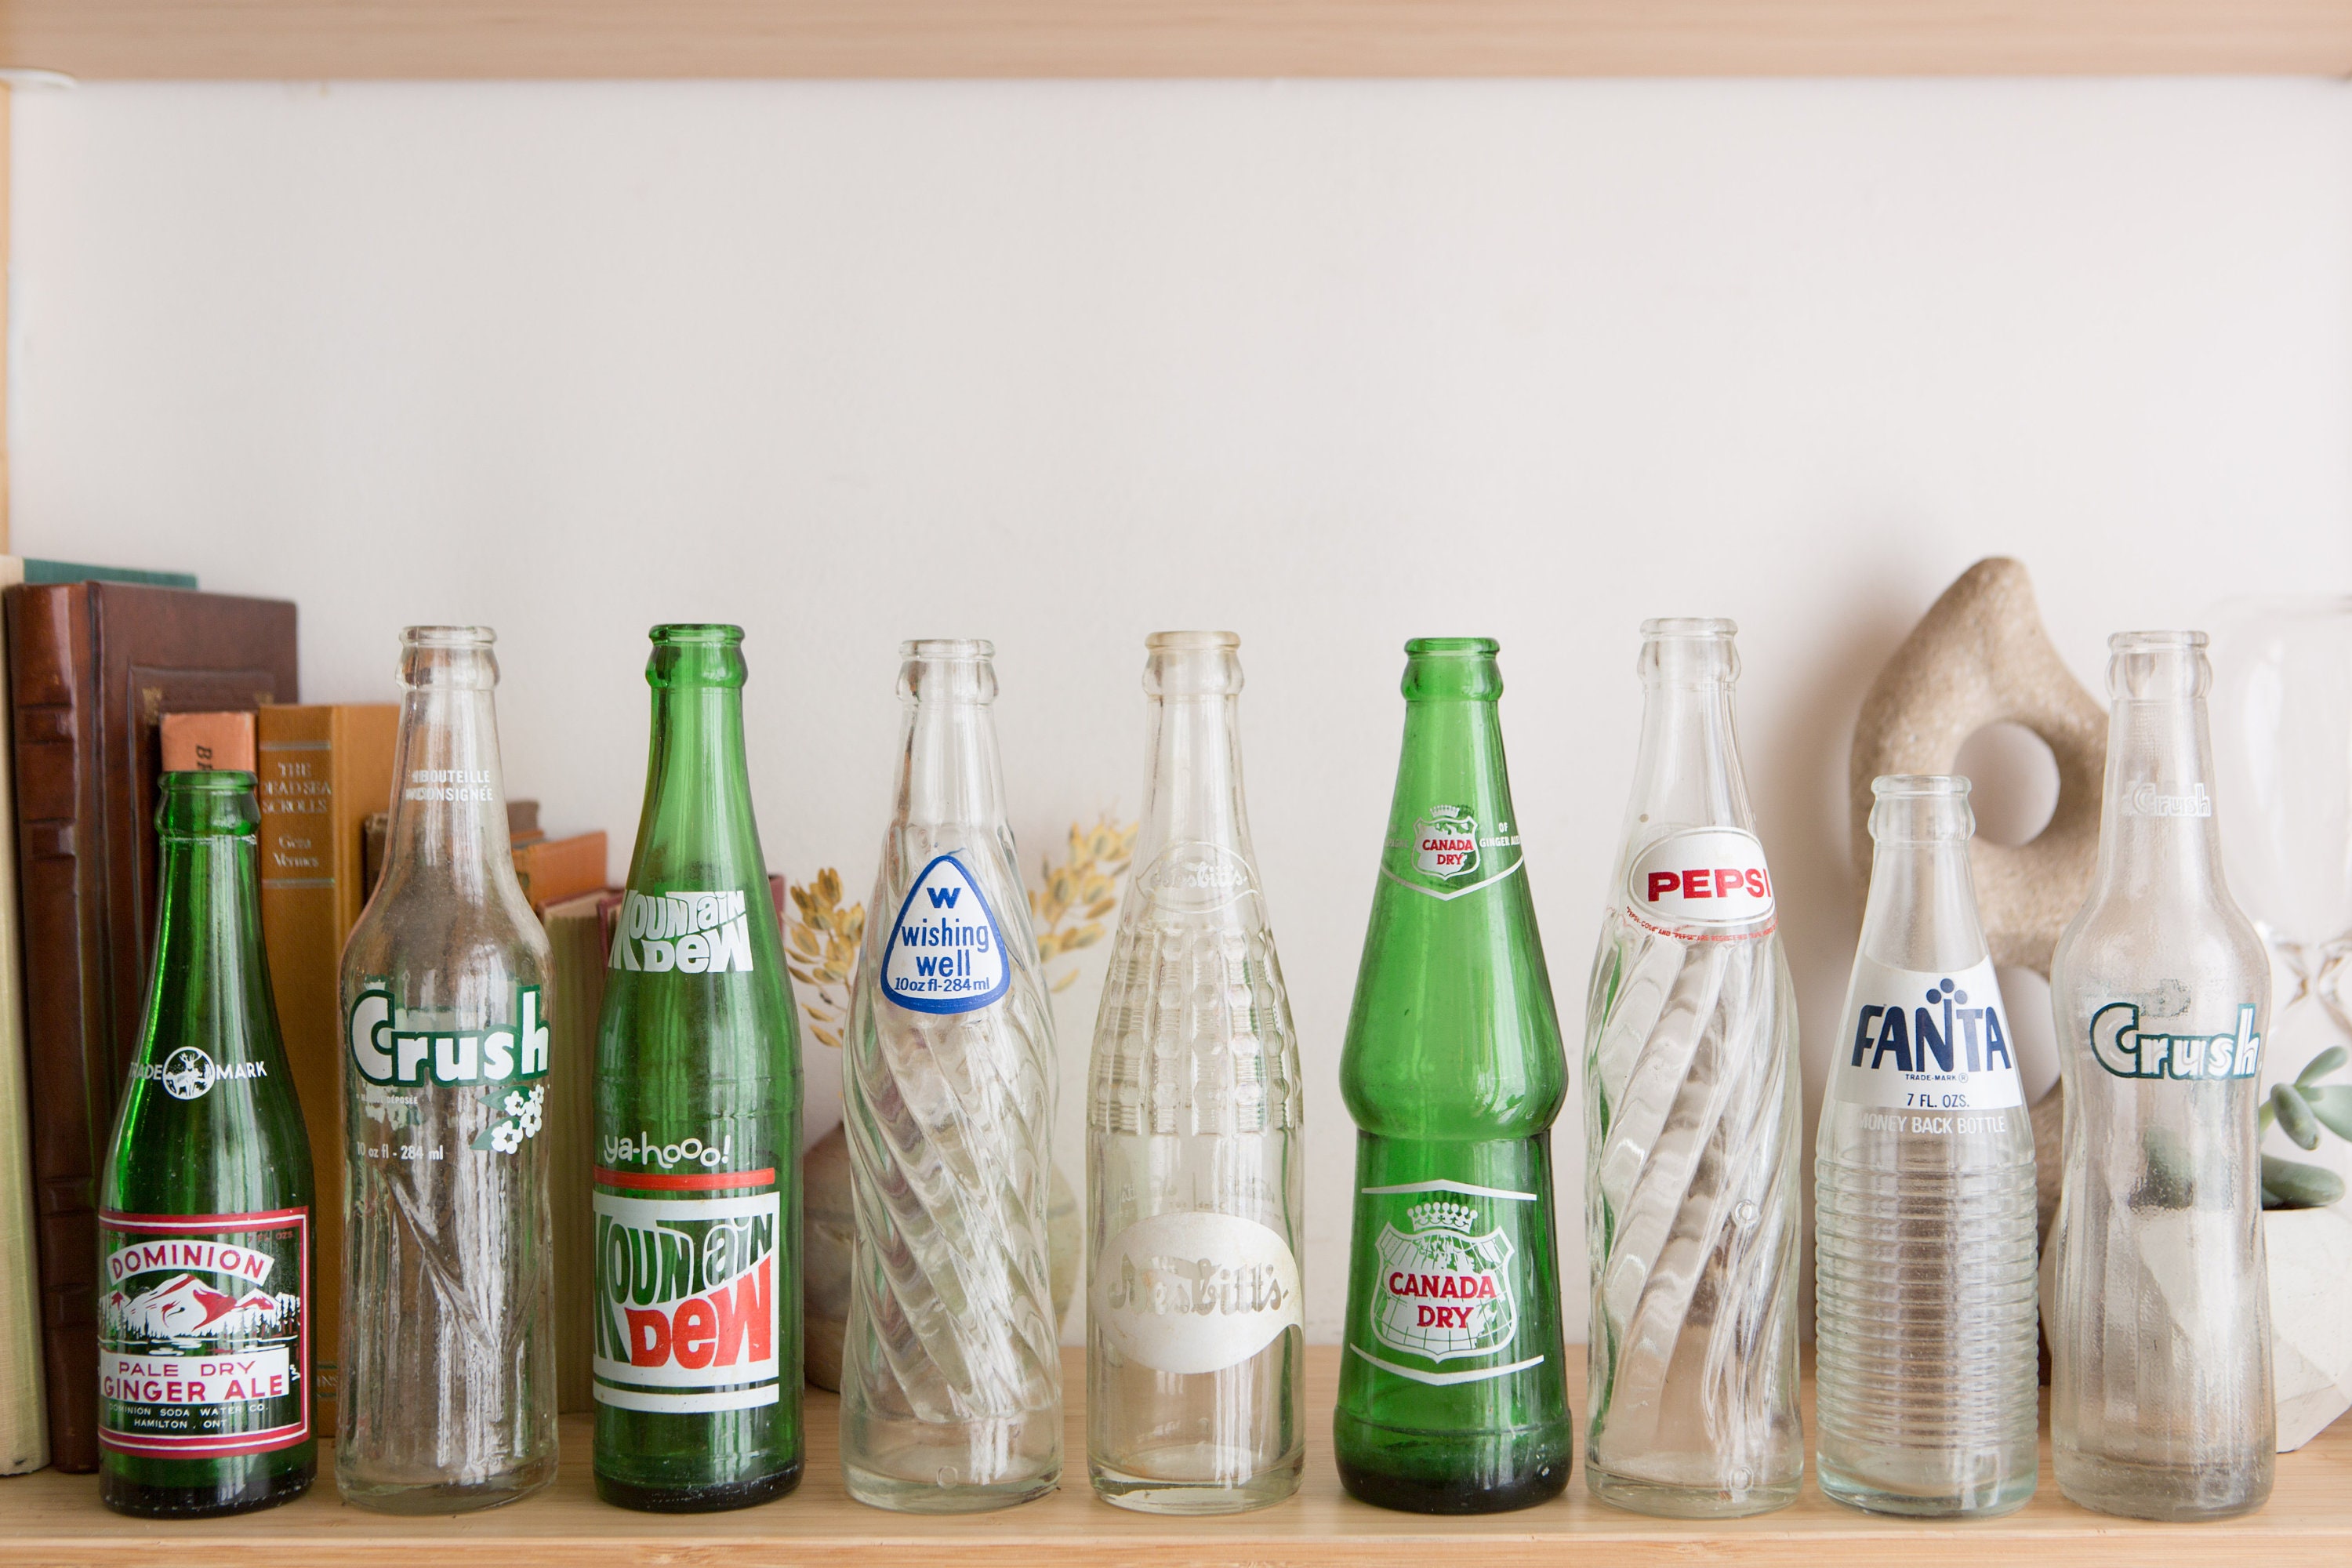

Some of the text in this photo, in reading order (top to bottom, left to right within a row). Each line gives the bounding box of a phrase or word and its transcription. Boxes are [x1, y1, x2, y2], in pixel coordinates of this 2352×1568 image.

[419, 769, 491, 783] BOUTEILLE
[2132, 782, 2212, 817] Crush
[1498, 822, 1508, 833] OF
[1422, 840, 1474, 851] CANADA
[1479, 836, 1510, 848] GINGER
[1436, 854, 1464, 866] DRY
[1648, 868, 1772, 902] PEPSI
[902, 917, 990, 953] wishing
[916, 949, 971, 978] well
[350, 984, 551, 1088] Crush
[1851, 998, 2013, 1073] FANTA
[2089, 1003, 2260, 1080] Crush
[129, 1061, 268, 1080] TRADE MARK
[1907, 1093, 1970, 1108] 7 FL. OZS.
[1911, 1116, 1953, 1134] BACK
[1957, 1116, 2006, 1134] BOTTLE
[368, 1148, 379, 1159] oz
[381, 1143, 389, 1159] fl
[401, 1145, 424, 1160] 284
[428, 1145, 444, 1160] ml
[604, 1131, 731, 1169] ya-hooo!
[111, 1244, 265, 1279] DOMINION
[1388, 1272, 1497, 1298] CANADA
[1417, 1305, 1474, 1329] DRY
[119, 1360, 256, 1377] PALE DRY
[103, 1374, 283, 1403] GINGER ALE
[159, 1408, 190, 1417] SODA
[200, 1404, 242, 1417] WATER
[249, 1403, 269, 1412] CO.
[134, 1419, 188, 1429] HAMILTON
